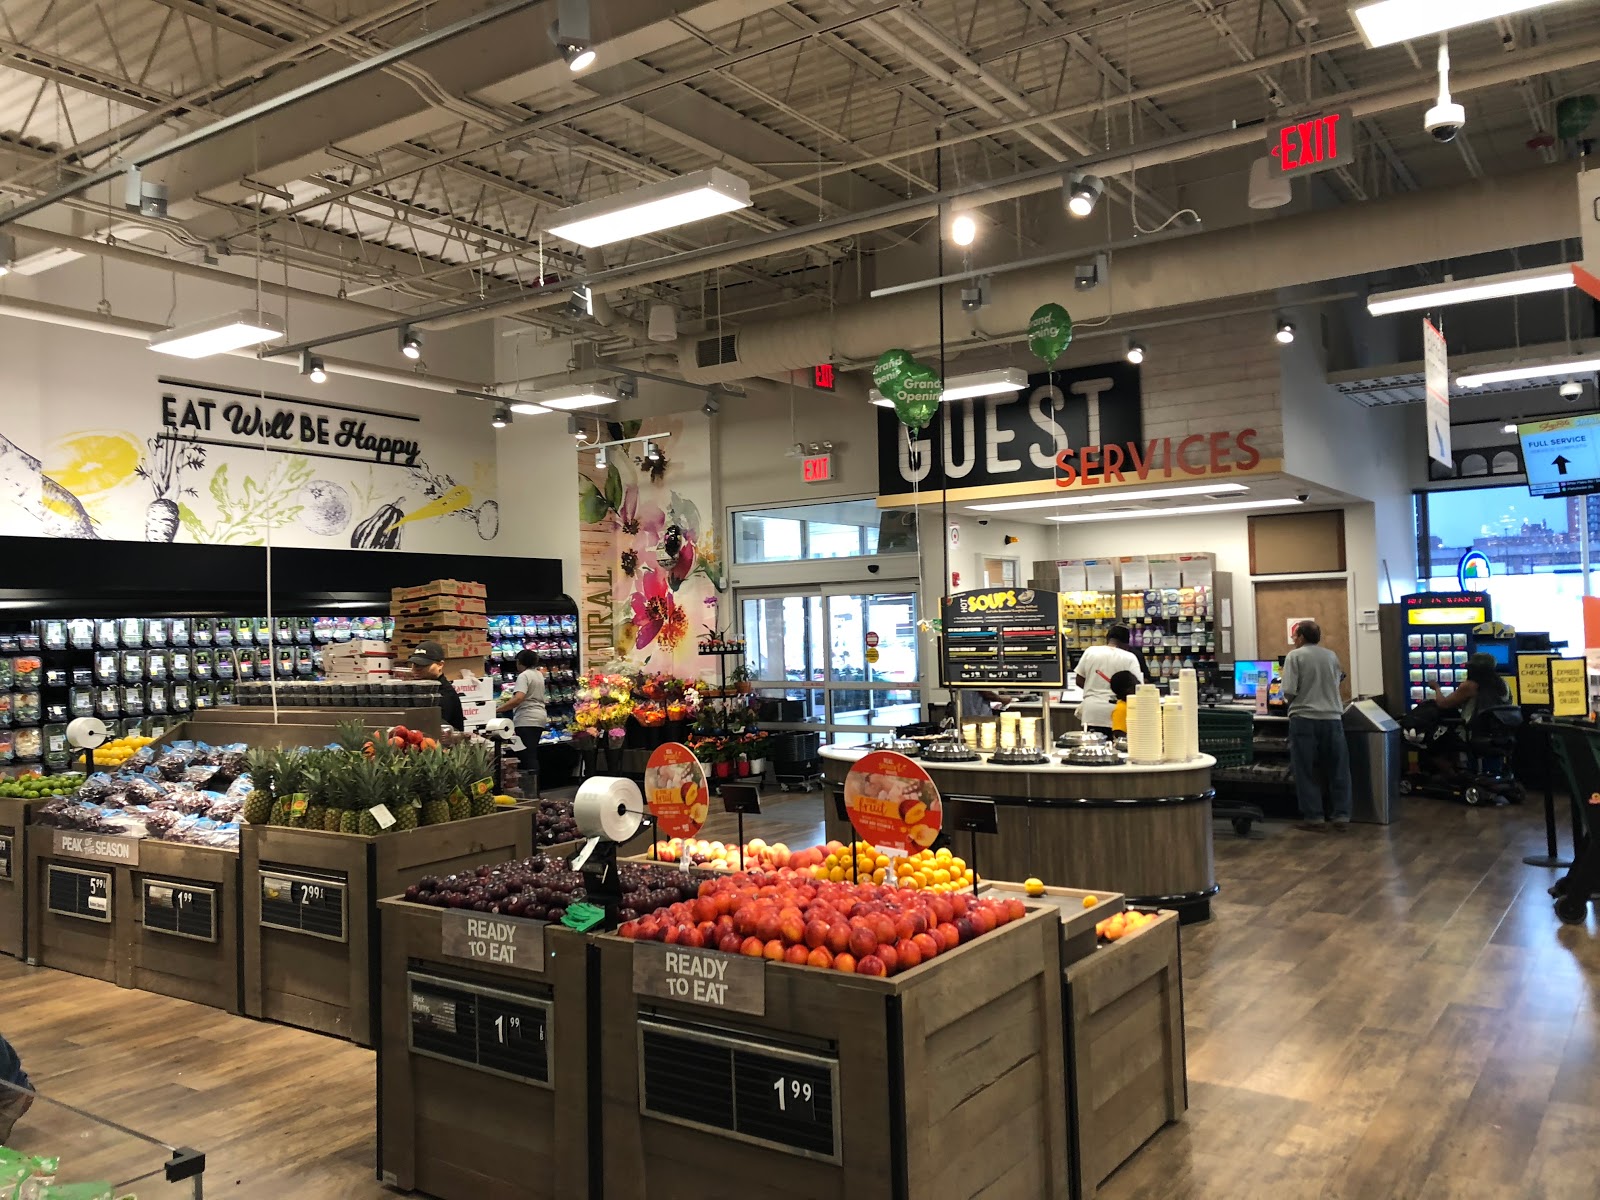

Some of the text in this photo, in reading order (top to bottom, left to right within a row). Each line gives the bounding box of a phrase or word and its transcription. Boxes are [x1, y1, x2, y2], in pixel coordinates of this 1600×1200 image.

[1281, 114, 1340, 171] EXIT
[873, 356, 904, 375] Grand
[897, 390, 940, 403] Openin
[904, 378, 941, 390] Grand
[161, 395, 422, 466] EAT Well BE Happy
[898, 376, 1115, 483] GUEST
[1528, 435, 1587, 448] FULL SERVICE
[803, 457, 829, 482] EXIT
[1055, 428, 1261, 488] SERVICES
[960, 598, 968, 613] HOT
[967, 590, 1017, 613] SOUPS
[586, 567, 614, 668] LORAL
[62, 836, 129, 859] PEAK OF THE SEASON
[467, 918, 517, 943] READY
[468, 941, 517, 964] TO EAT
[665, 951, 729, 981] READY
[665, 978, 729, 1006] TO EAT
